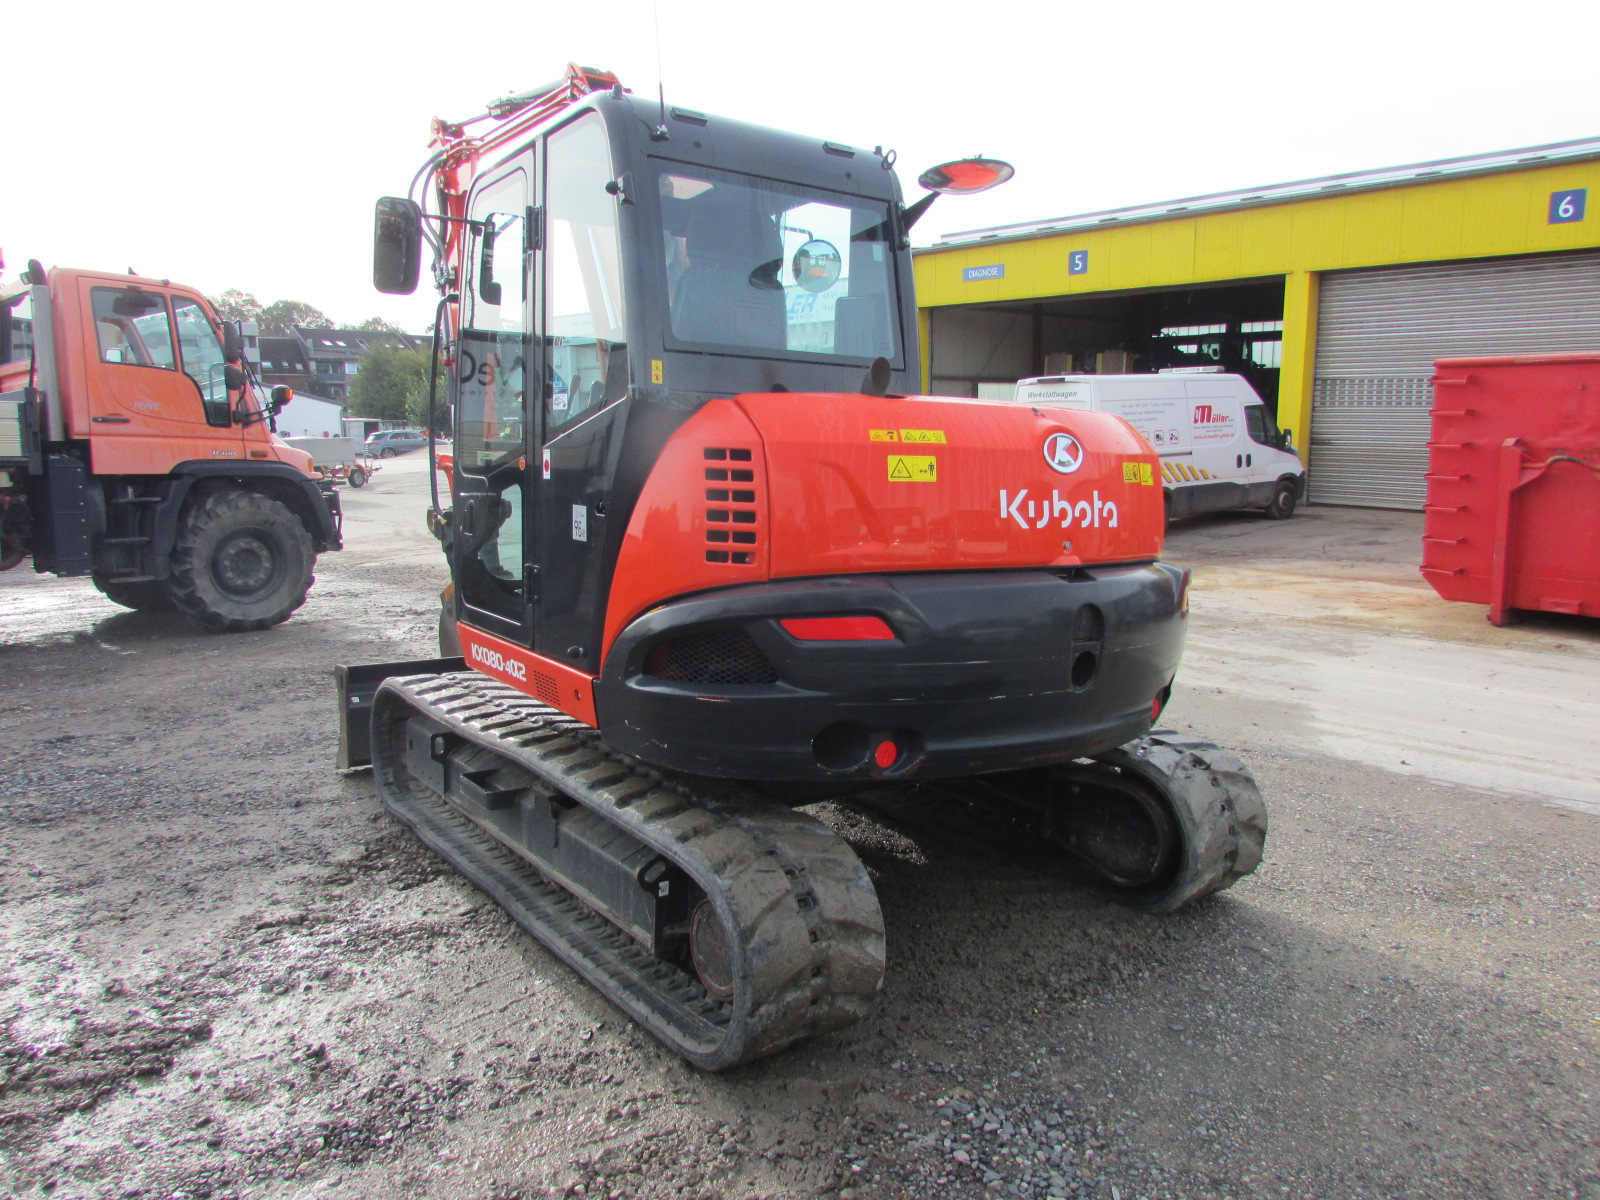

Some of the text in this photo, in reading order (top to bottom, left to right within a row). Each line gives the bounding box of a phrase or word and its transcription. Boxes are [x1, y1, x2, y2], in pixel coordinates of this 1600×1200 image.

[1558, 195, 1574, 218] 6
[1074, 254, 1083, 271] 5
[968, 267, 998, 278] DIAGNOSE
[1027, 391, 1078, 400] Werkstattwagen
[1000, 489, 1118, 529] Kubota
